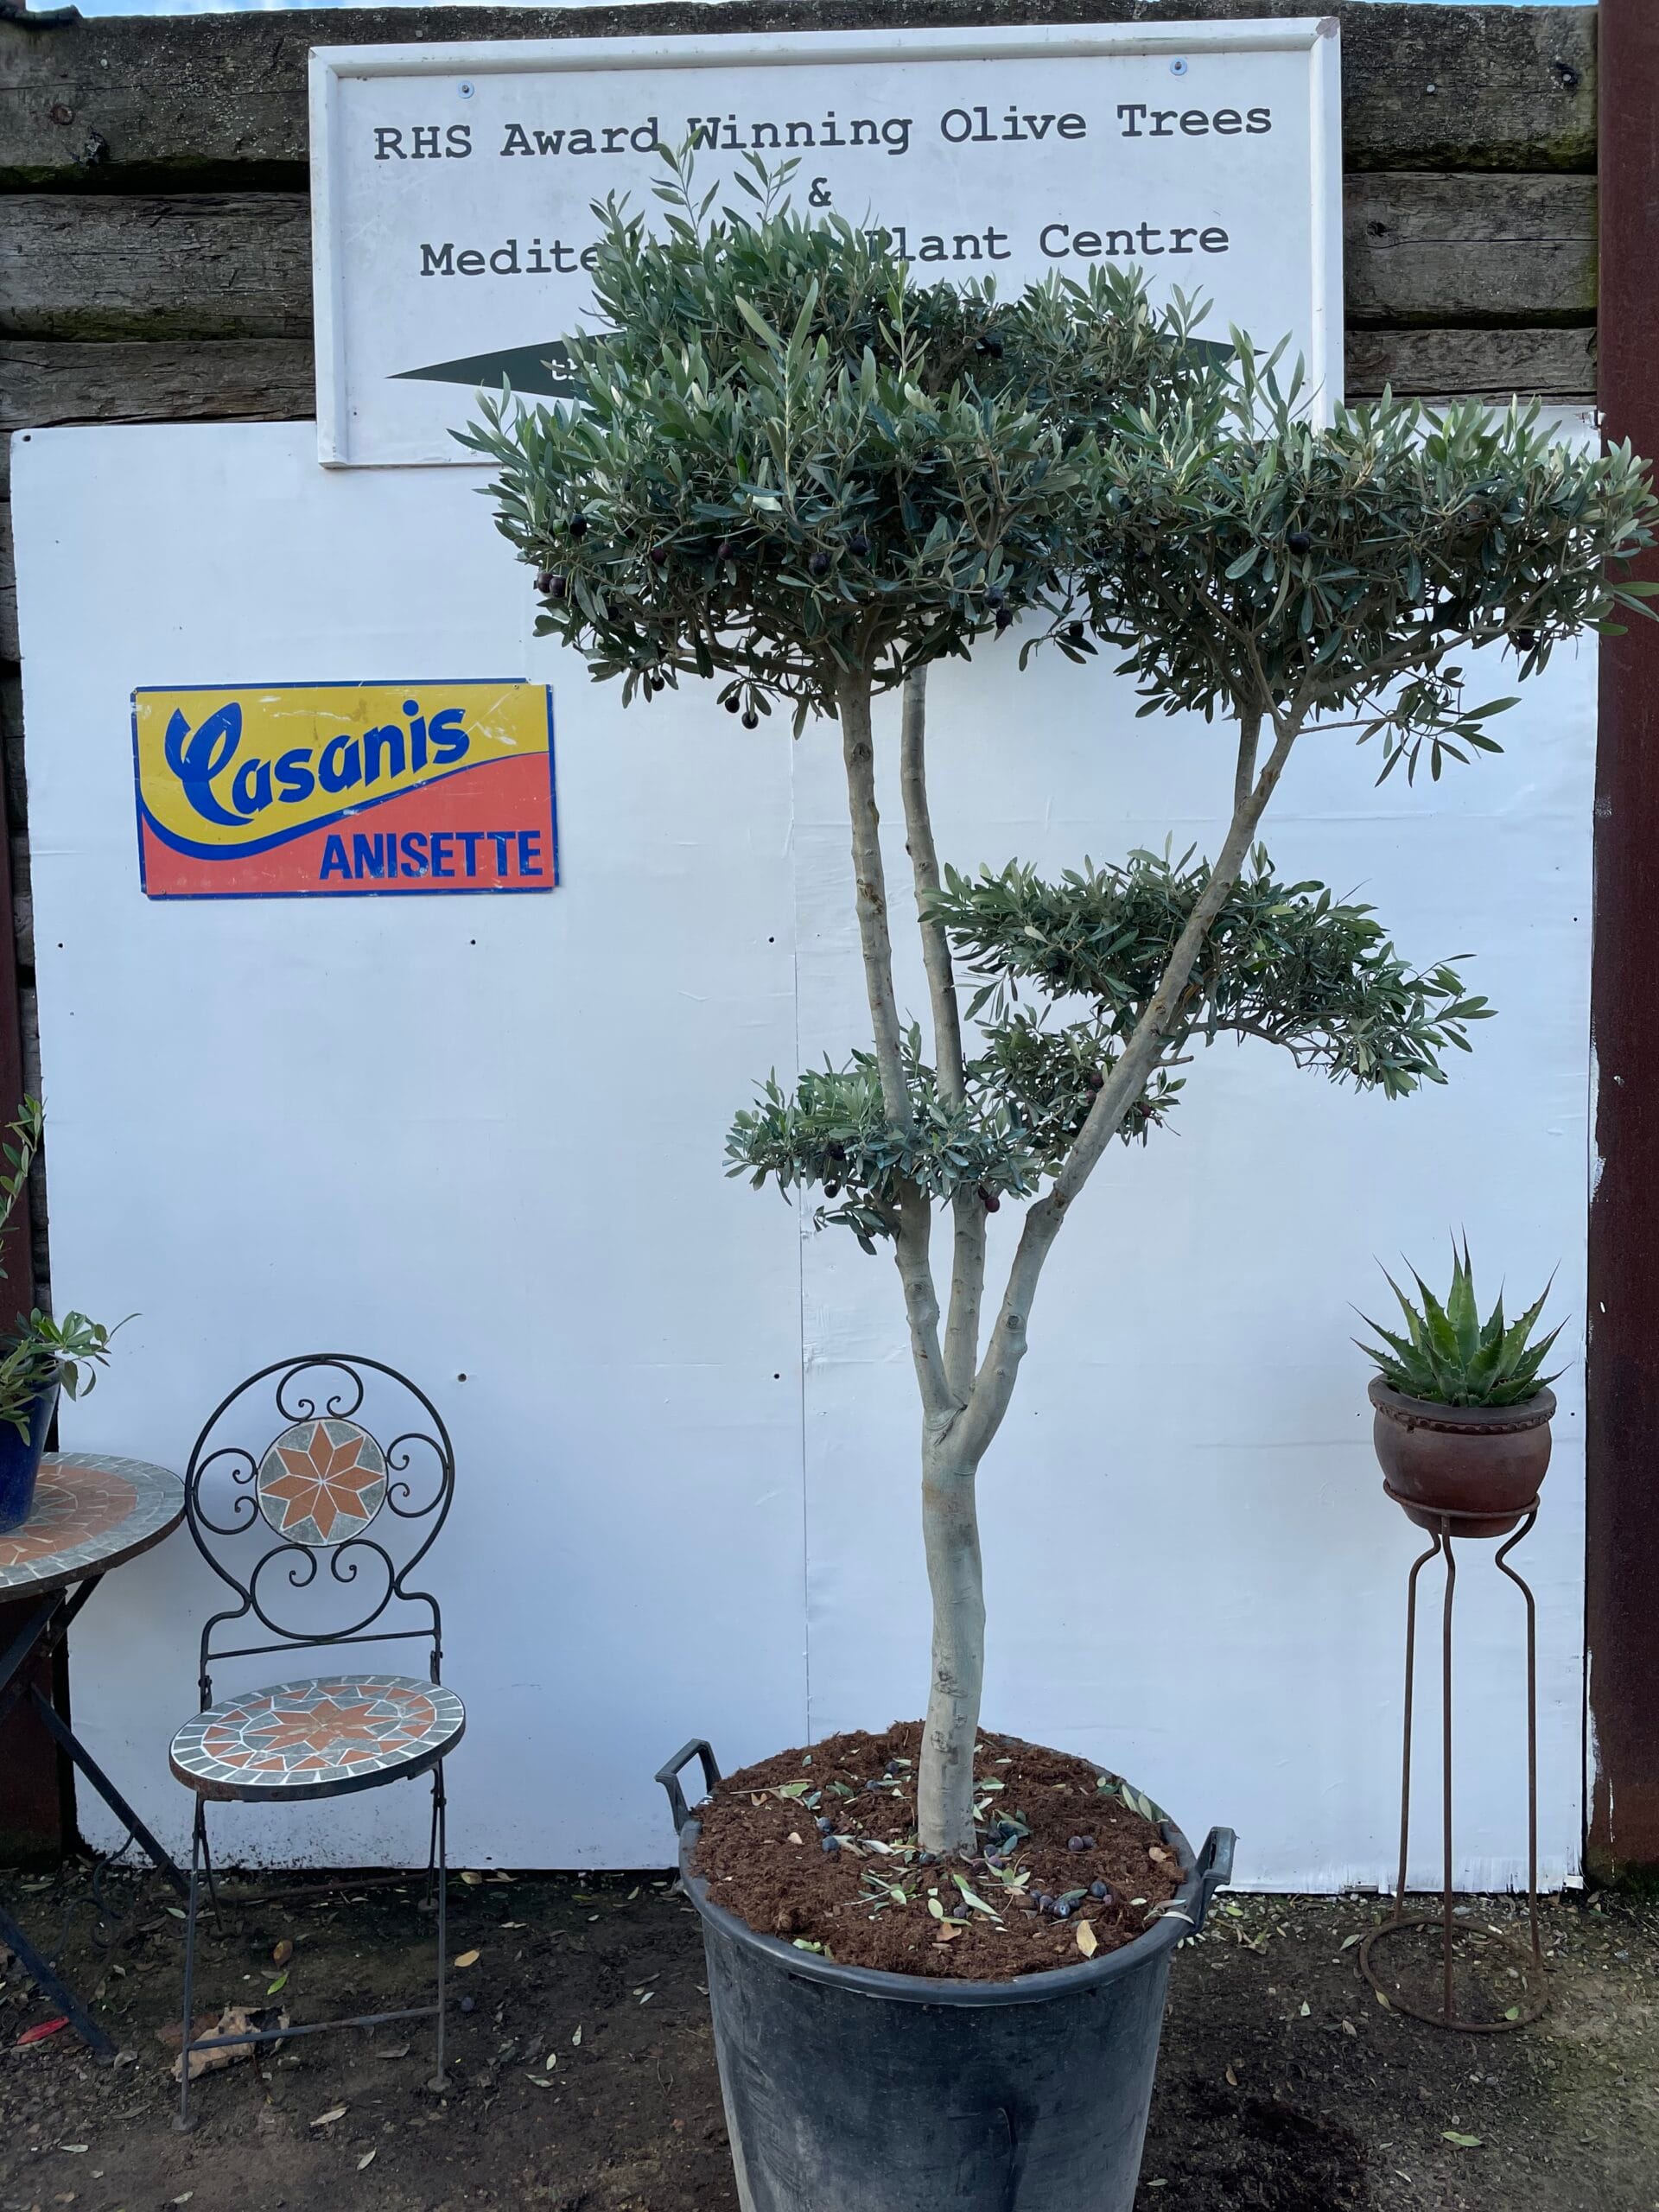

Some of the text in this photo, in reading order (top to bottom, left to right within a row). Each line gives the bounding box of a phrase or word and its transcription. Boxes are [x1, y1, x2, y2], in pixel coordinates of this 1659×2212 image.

[373, 103, 1273, 160] RHS Award Winning Olive Trees
[808, 177, 832, 207] &
[1039, 221, 1230, 257] Centre
[164, 699, 471, 827] Casanis
[319, 830, 543, 880] ANISETTE
